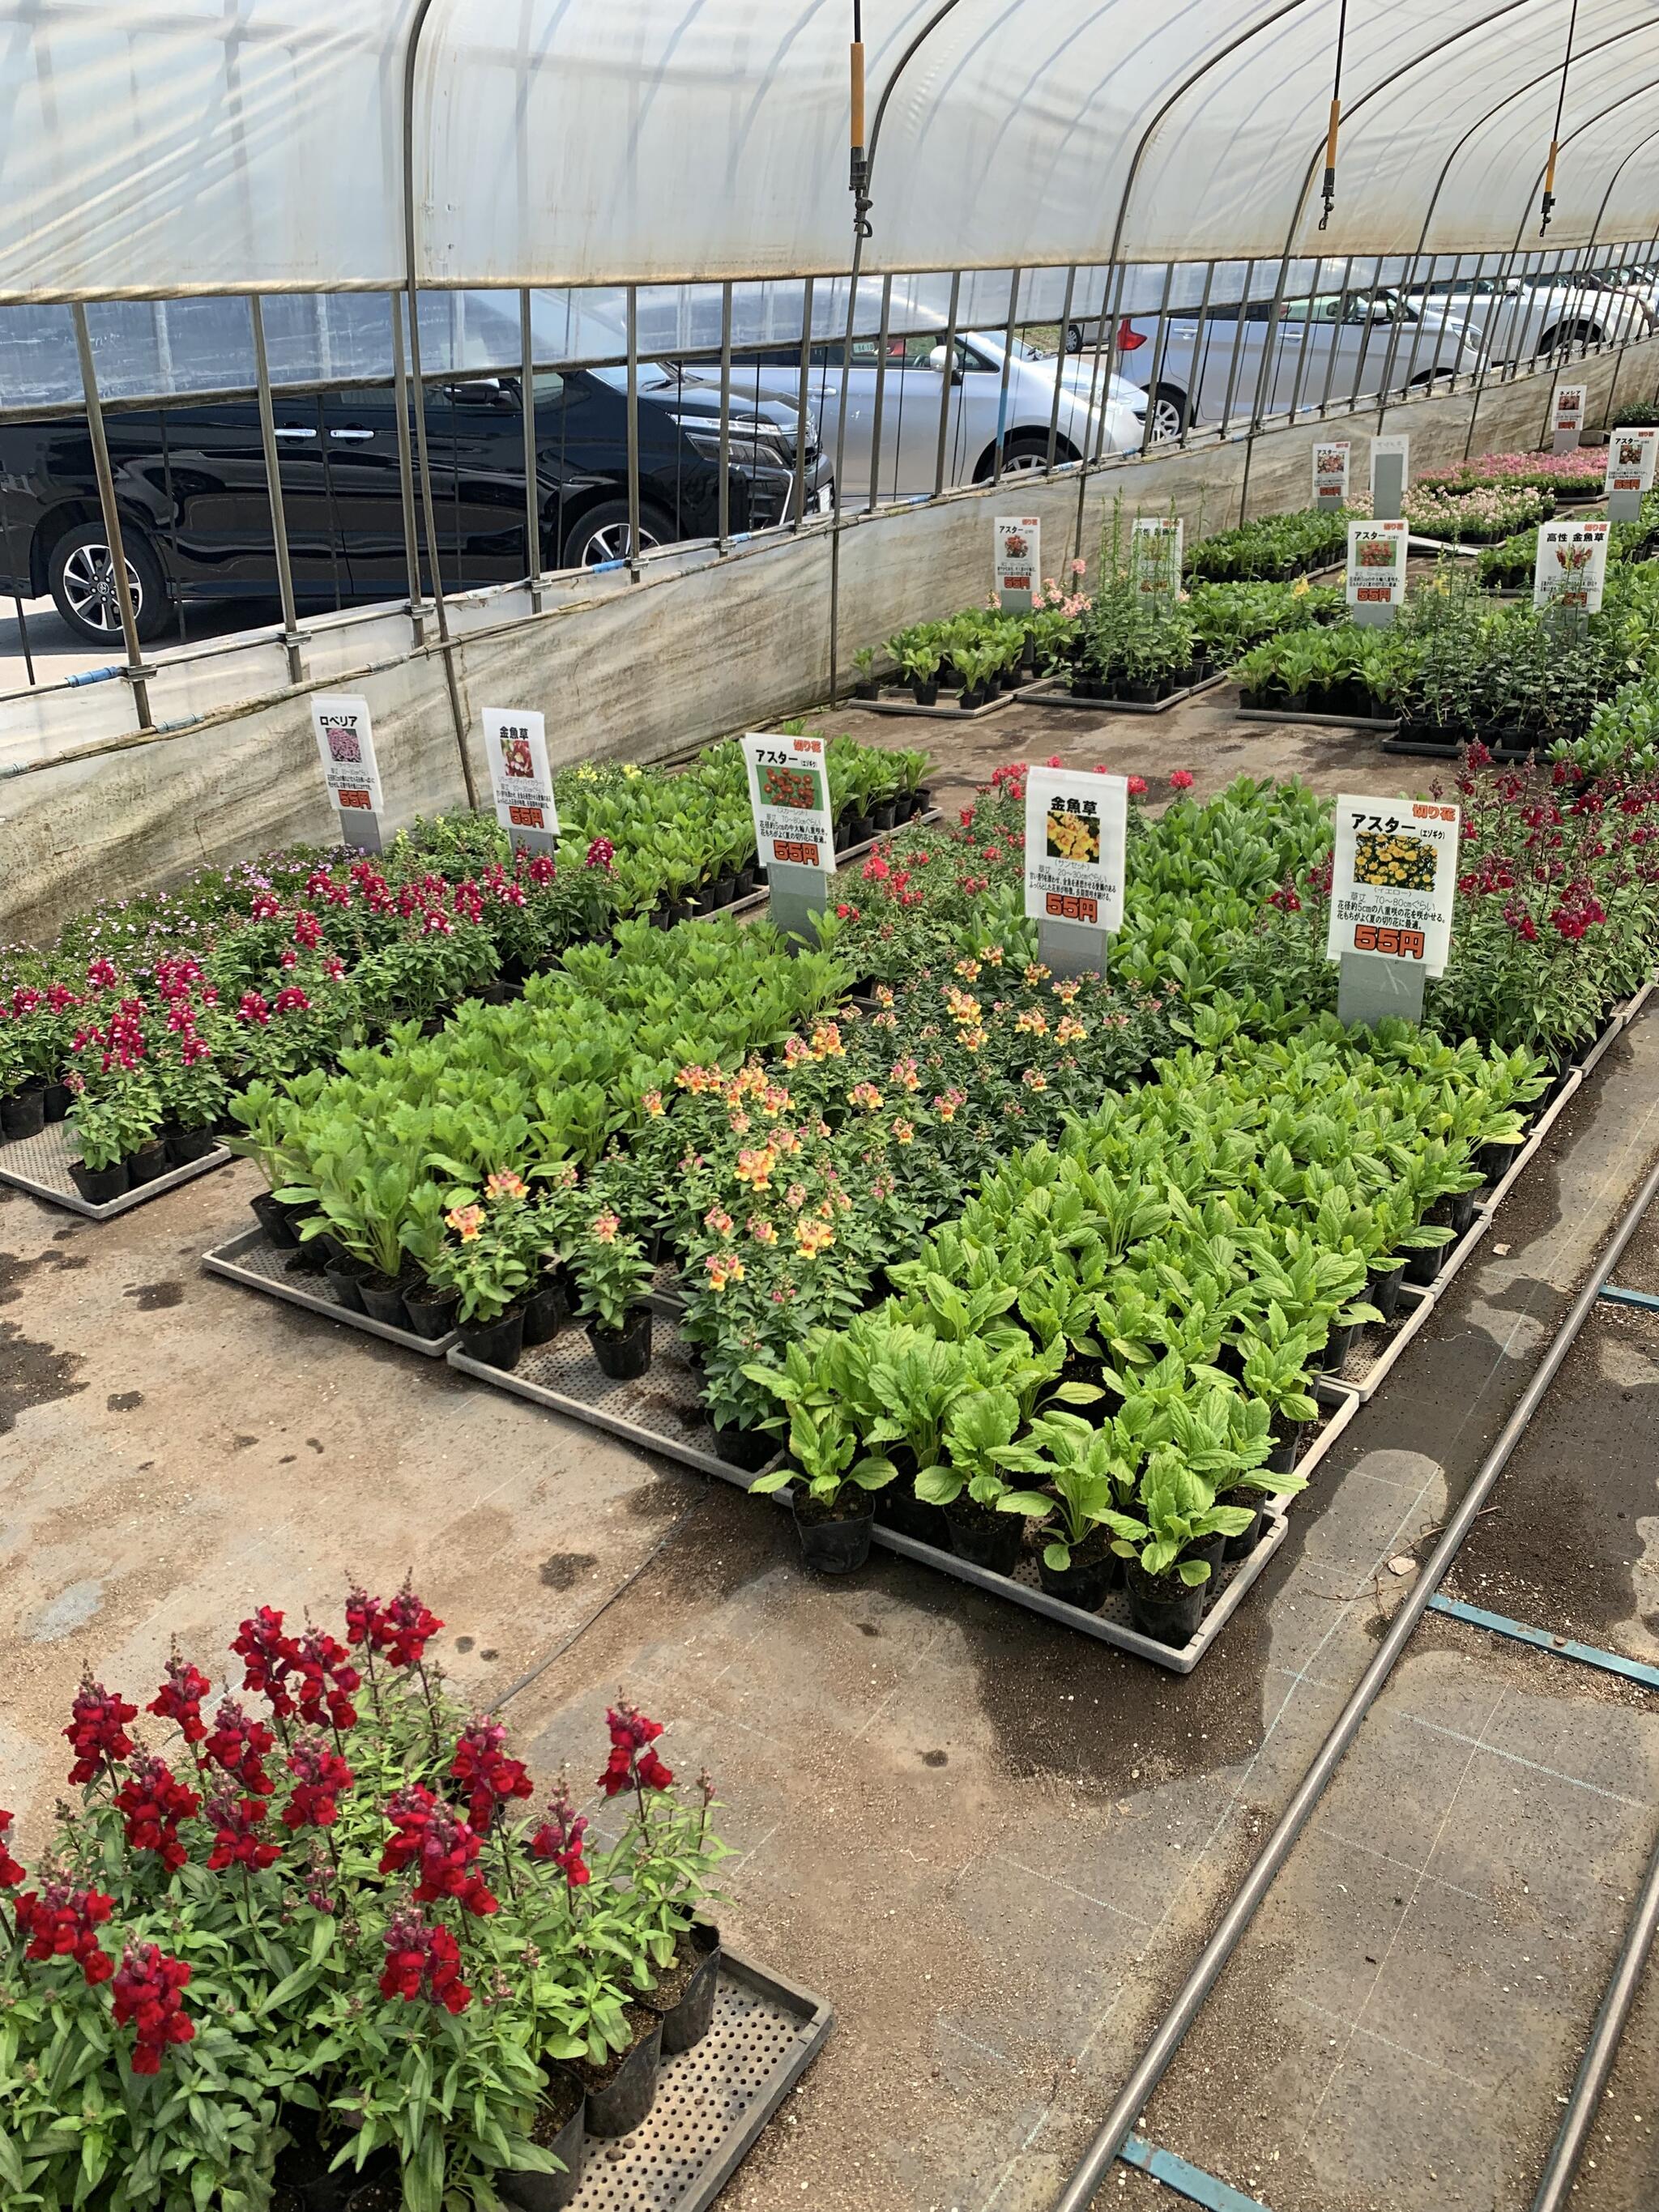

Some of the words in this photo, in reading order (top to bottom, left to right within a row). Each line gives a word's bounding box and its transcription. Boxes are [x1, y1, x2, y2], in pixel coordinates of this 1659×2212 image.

[999, 526, 1023, 534] アスター
[1354, 531, 1386, 540] アスター
[1546, 533, 1567, 542] 高性
[1572, 532, 1605, 542] 金魚草
[1357, 587, 1392, 603] 55円
[319, 716, 358, 727] ロベリア
[500, 726, 529, 740] 金魚草
[794, 739, 821, 753] 切り花
[755, 749, 798, 765] アスター
[338, 789, 372, 810] 55円
[1051, 796, 1098, 816] 金魚草
[509, 805, 544, 829] 55円
[1413, 804, 1456, 821] 切り花
[1351, 813, 1416, 833] アスター
[773, 839, 820, 867] 55円
[1046, 892, 1098, 923] 55円
[1354, 923, 1425, 959] 55円
